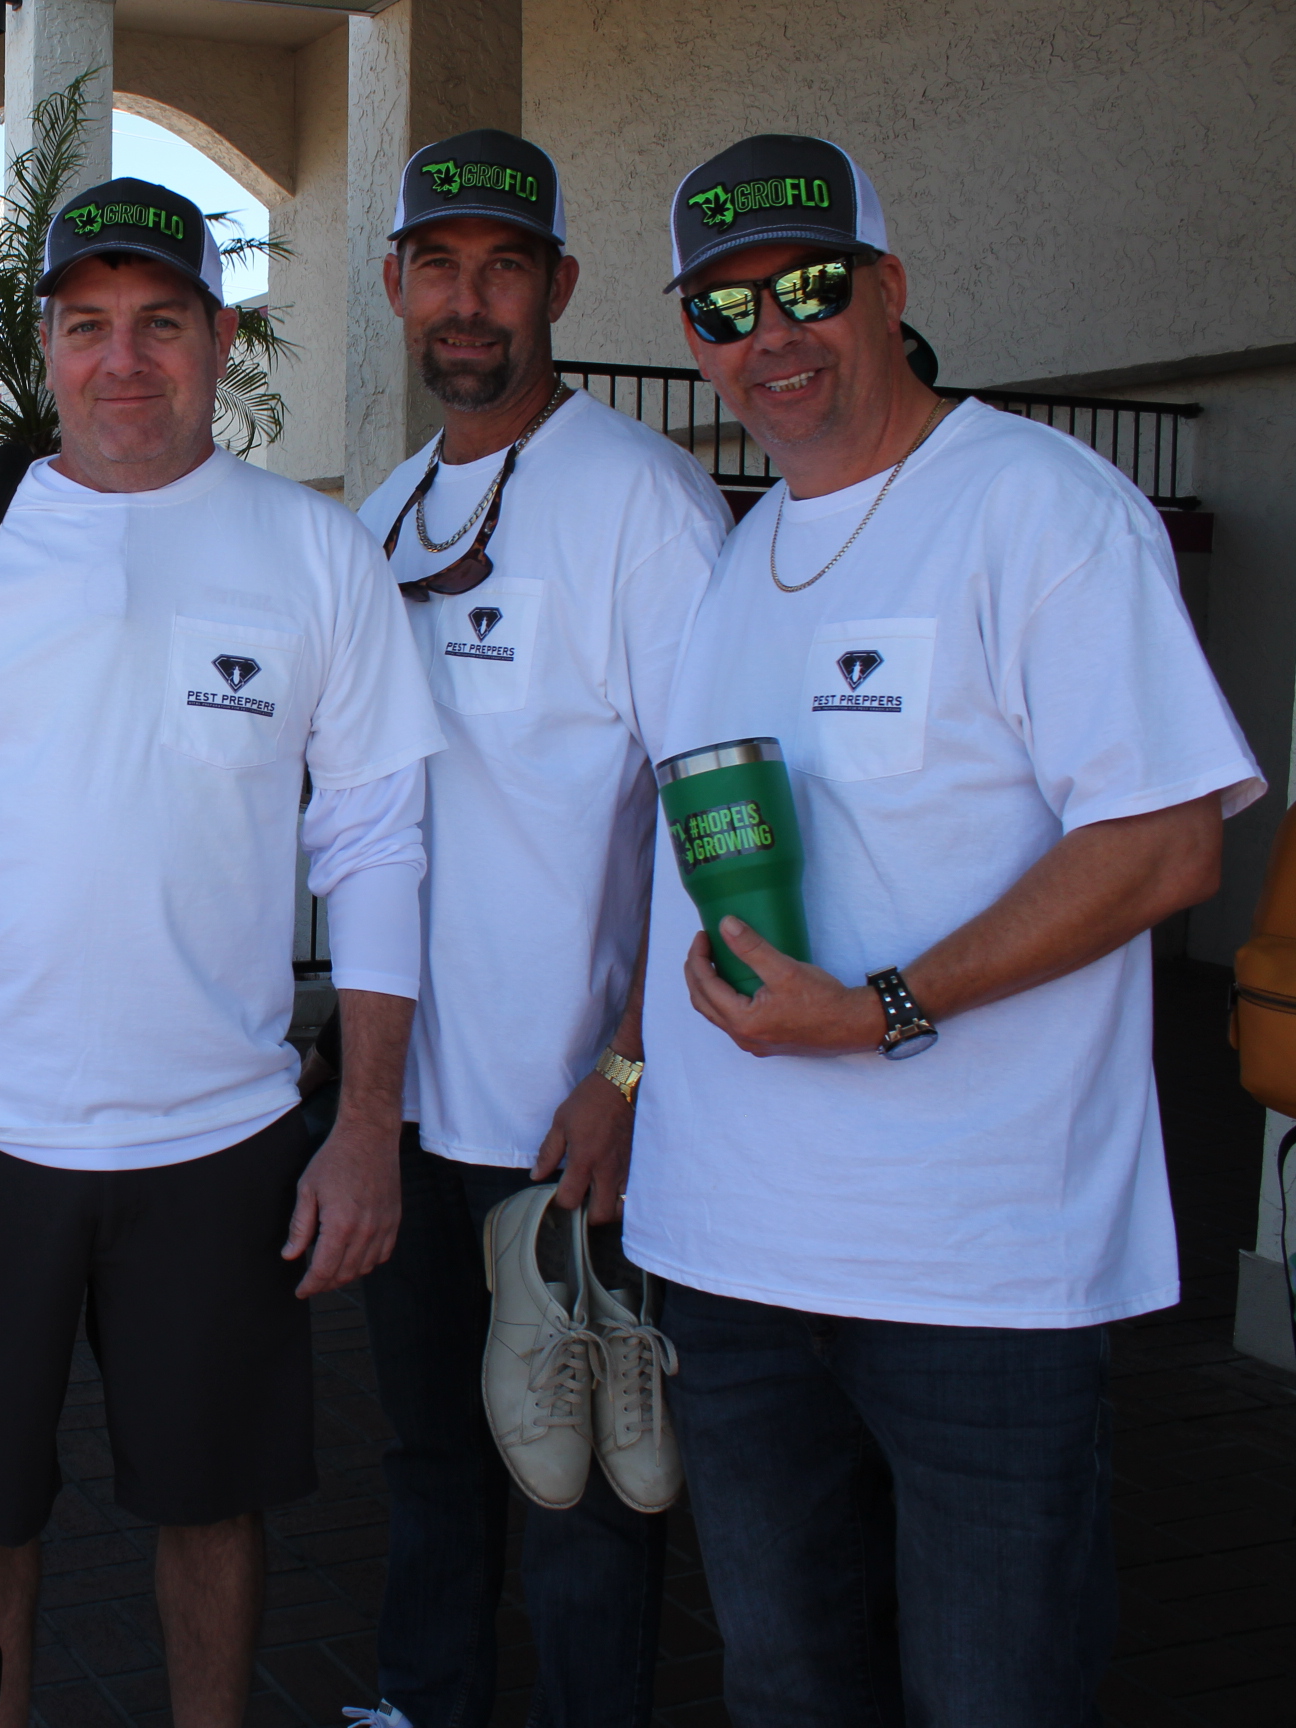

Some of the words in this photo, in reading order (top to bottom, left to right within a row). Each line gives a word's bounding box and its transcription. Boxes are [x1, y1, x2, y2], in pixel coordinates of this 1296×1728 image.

[462, 163, 538, 201] GROFLO
[734, 178, 830, 213] GROFLO
[104, 203, 184, 240] GROFLO
[446, 641, 467, 652] PEST
[468, 643, 515, 656] PREPPERS
[187, 690, 218, 702] PEST
[221, 694, 275, 712] PREPPERS
[812, 695, 837, 706] PEST
[839, 694, 903, 707] PREPPERS
[689, 803, 760, 838] #HOPEIS
[693, 824, 772, 860] GROWING
